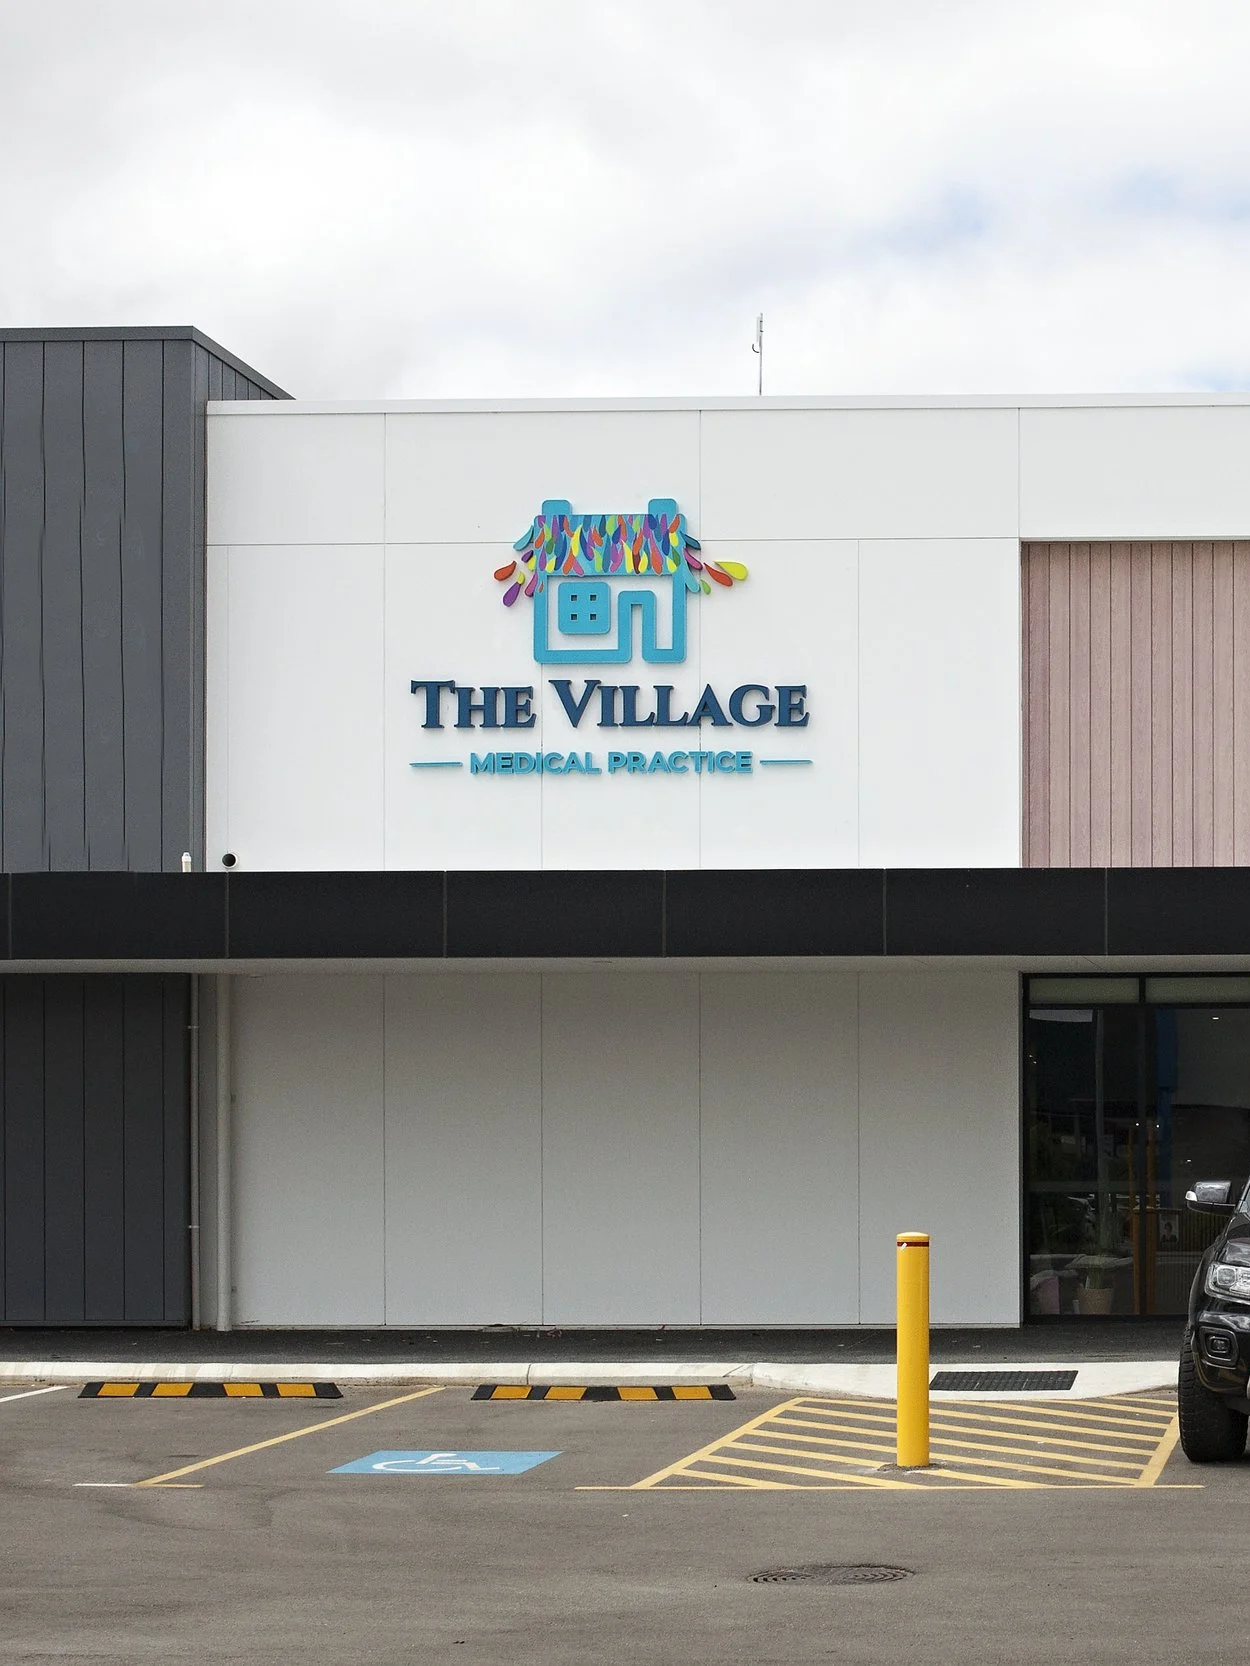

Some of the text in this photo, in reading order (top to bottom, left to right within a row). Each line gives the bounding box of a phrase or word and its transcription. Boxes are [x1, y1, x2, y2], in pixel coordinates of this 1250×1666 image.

[410, 679, 810, 729] THE VILLAGE
[470, 750, 753, 775] MEDICAL PRACTICE
